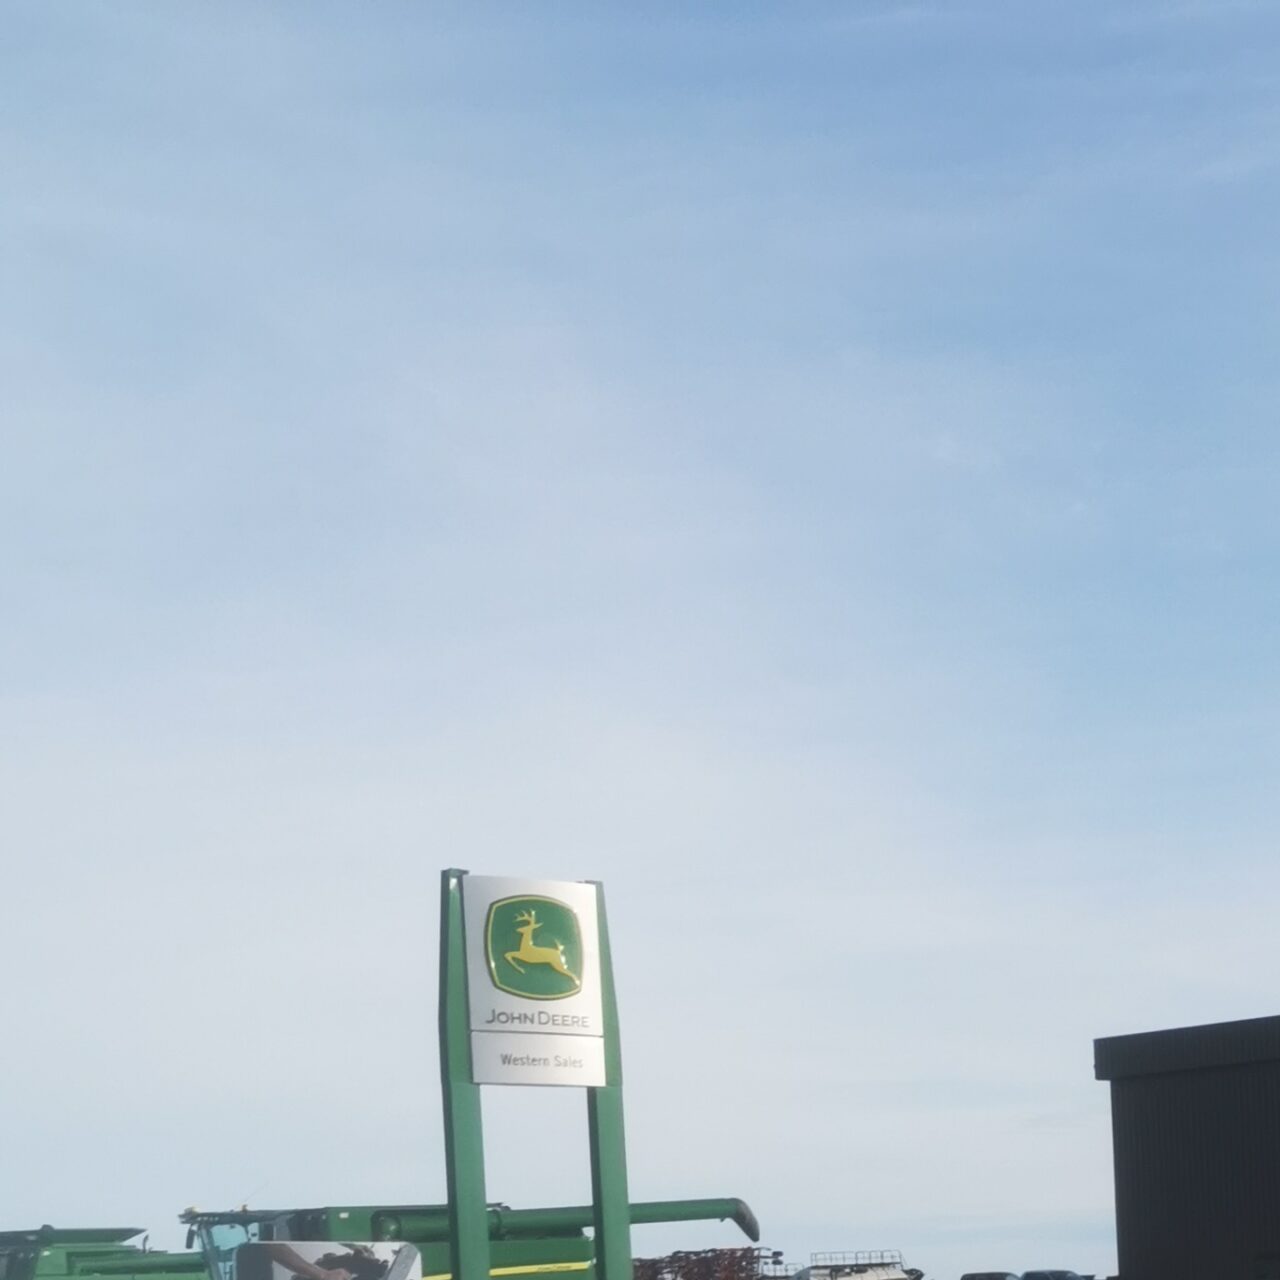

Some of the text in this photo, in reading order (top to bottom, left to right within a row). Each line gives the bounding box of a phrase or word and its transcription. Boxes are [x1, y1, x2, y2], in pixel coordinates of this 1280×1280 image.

[485, 1009, 590, 1028] JOHN DEERE
[500, 1053, 584, 1069] Western Sales
